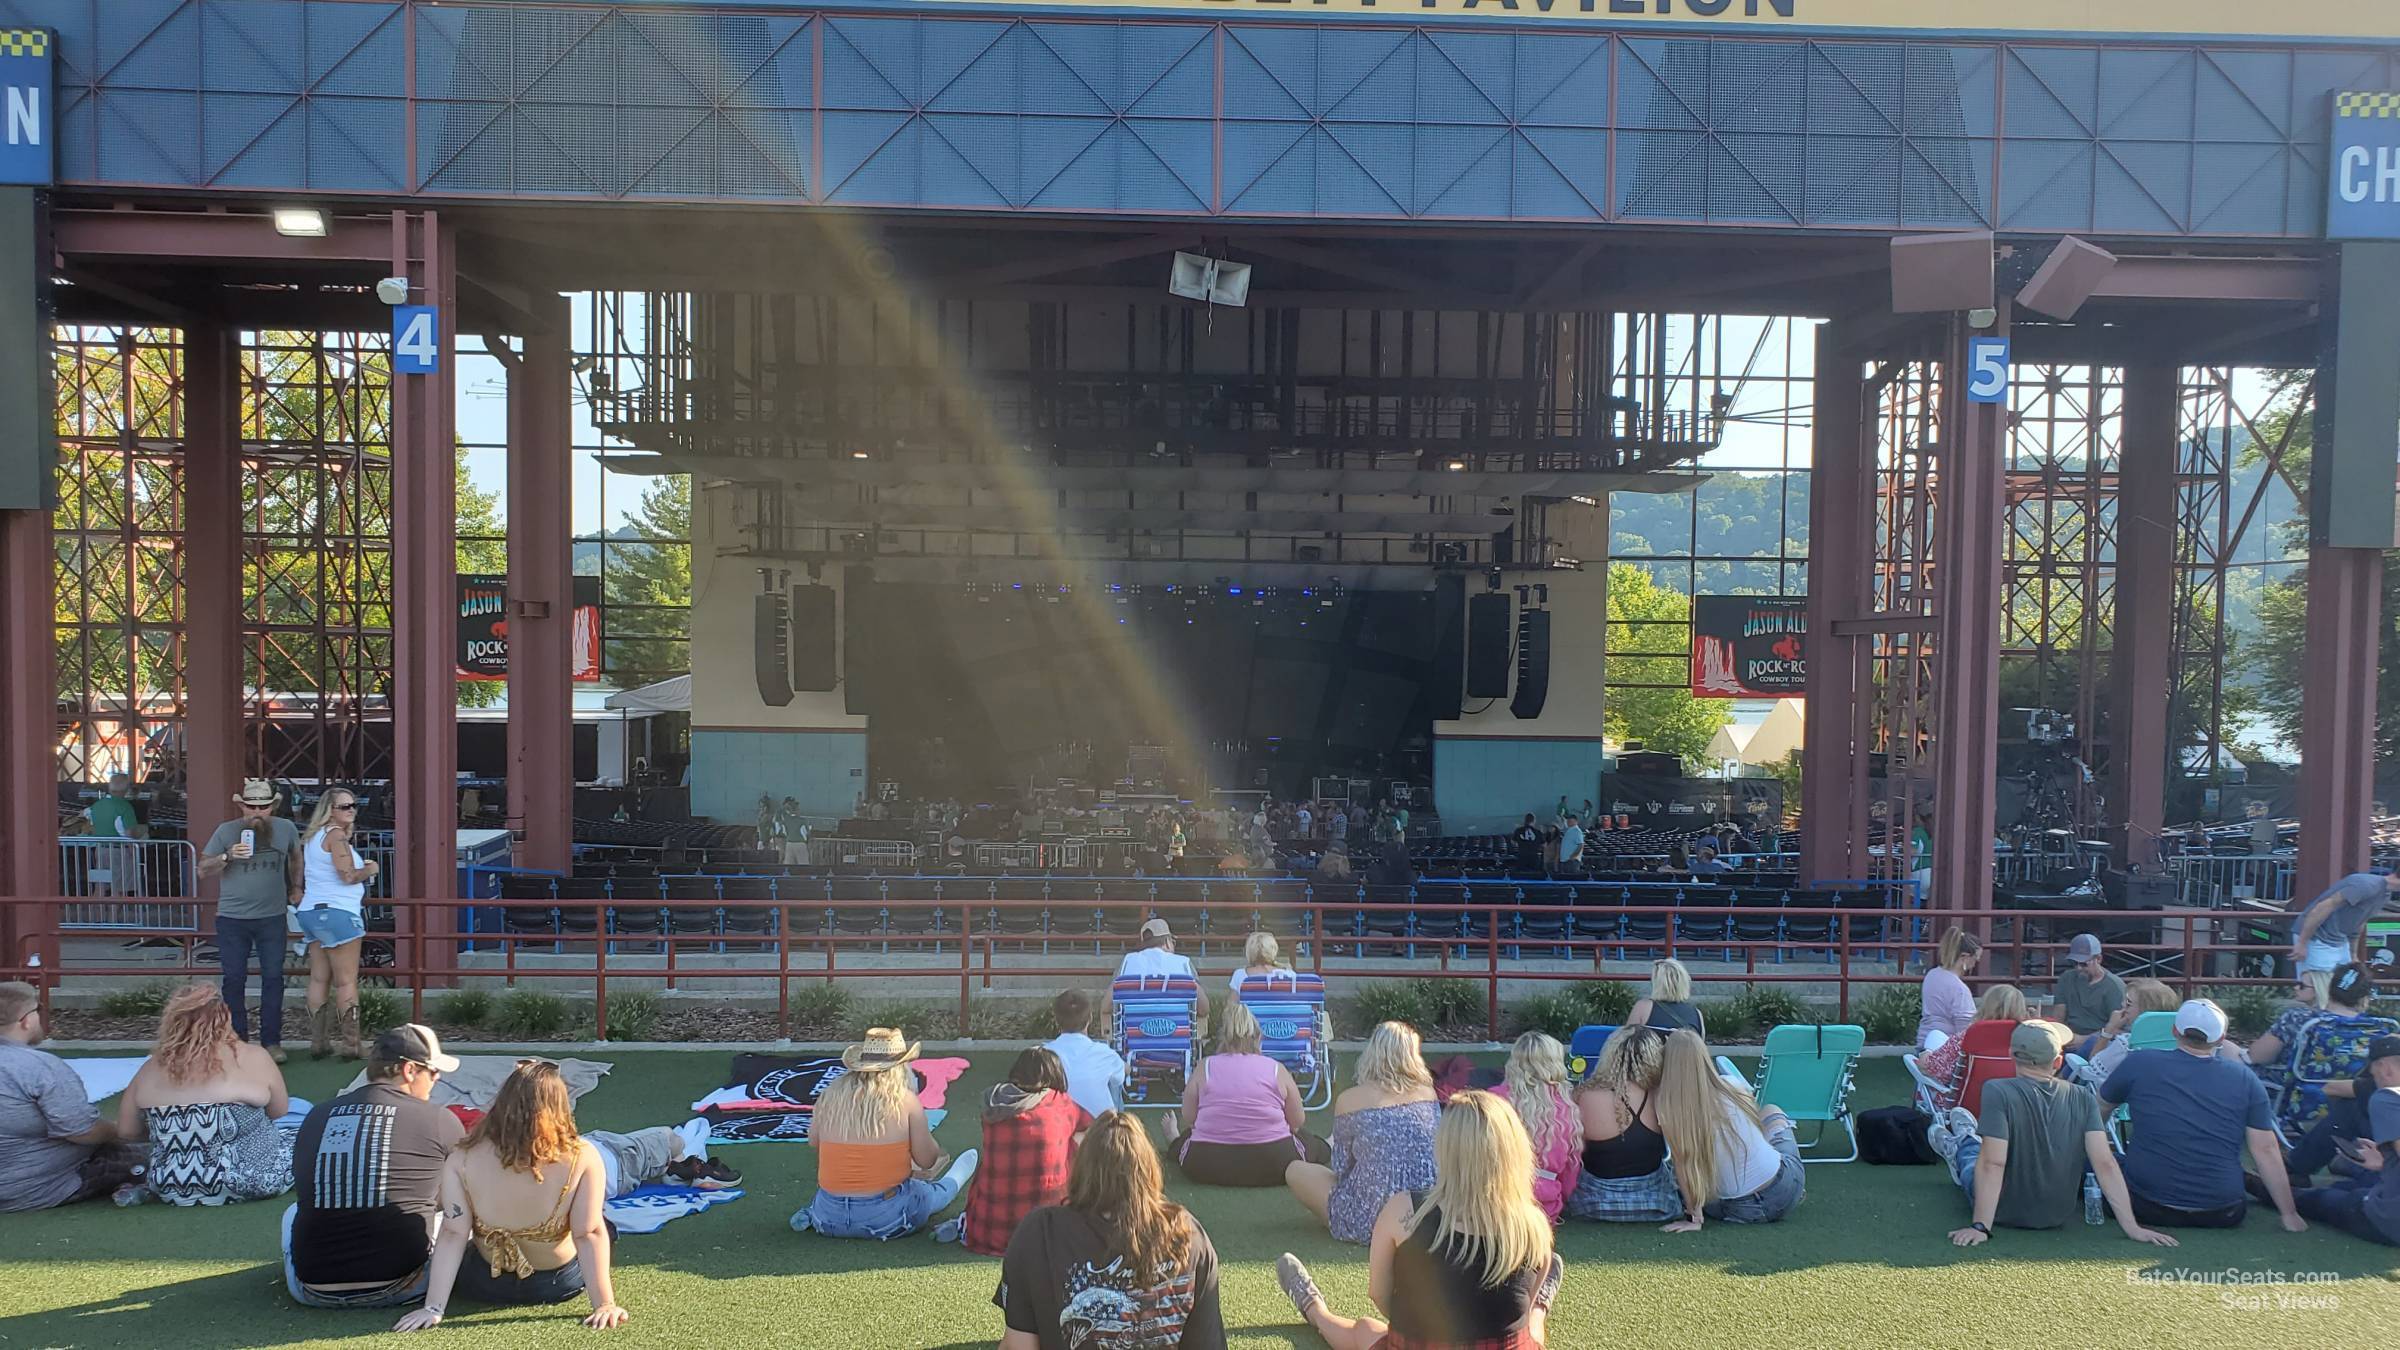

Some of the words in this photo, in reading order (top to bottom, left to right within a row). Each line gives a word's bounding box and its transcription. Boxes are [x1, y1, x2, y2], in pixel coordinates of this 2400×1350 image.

[397, 313, 437, 365] 4
[1969, 344, 2006, 397] 5
[461, 588, 502, 617] JASON
[1743, 609, 1783, 637] JASON
[467, 640, 504, 662] ROCK
[1748, 660, 1783, 680] ROCK
[329, 1104, 398, 1116] FREEDOM
